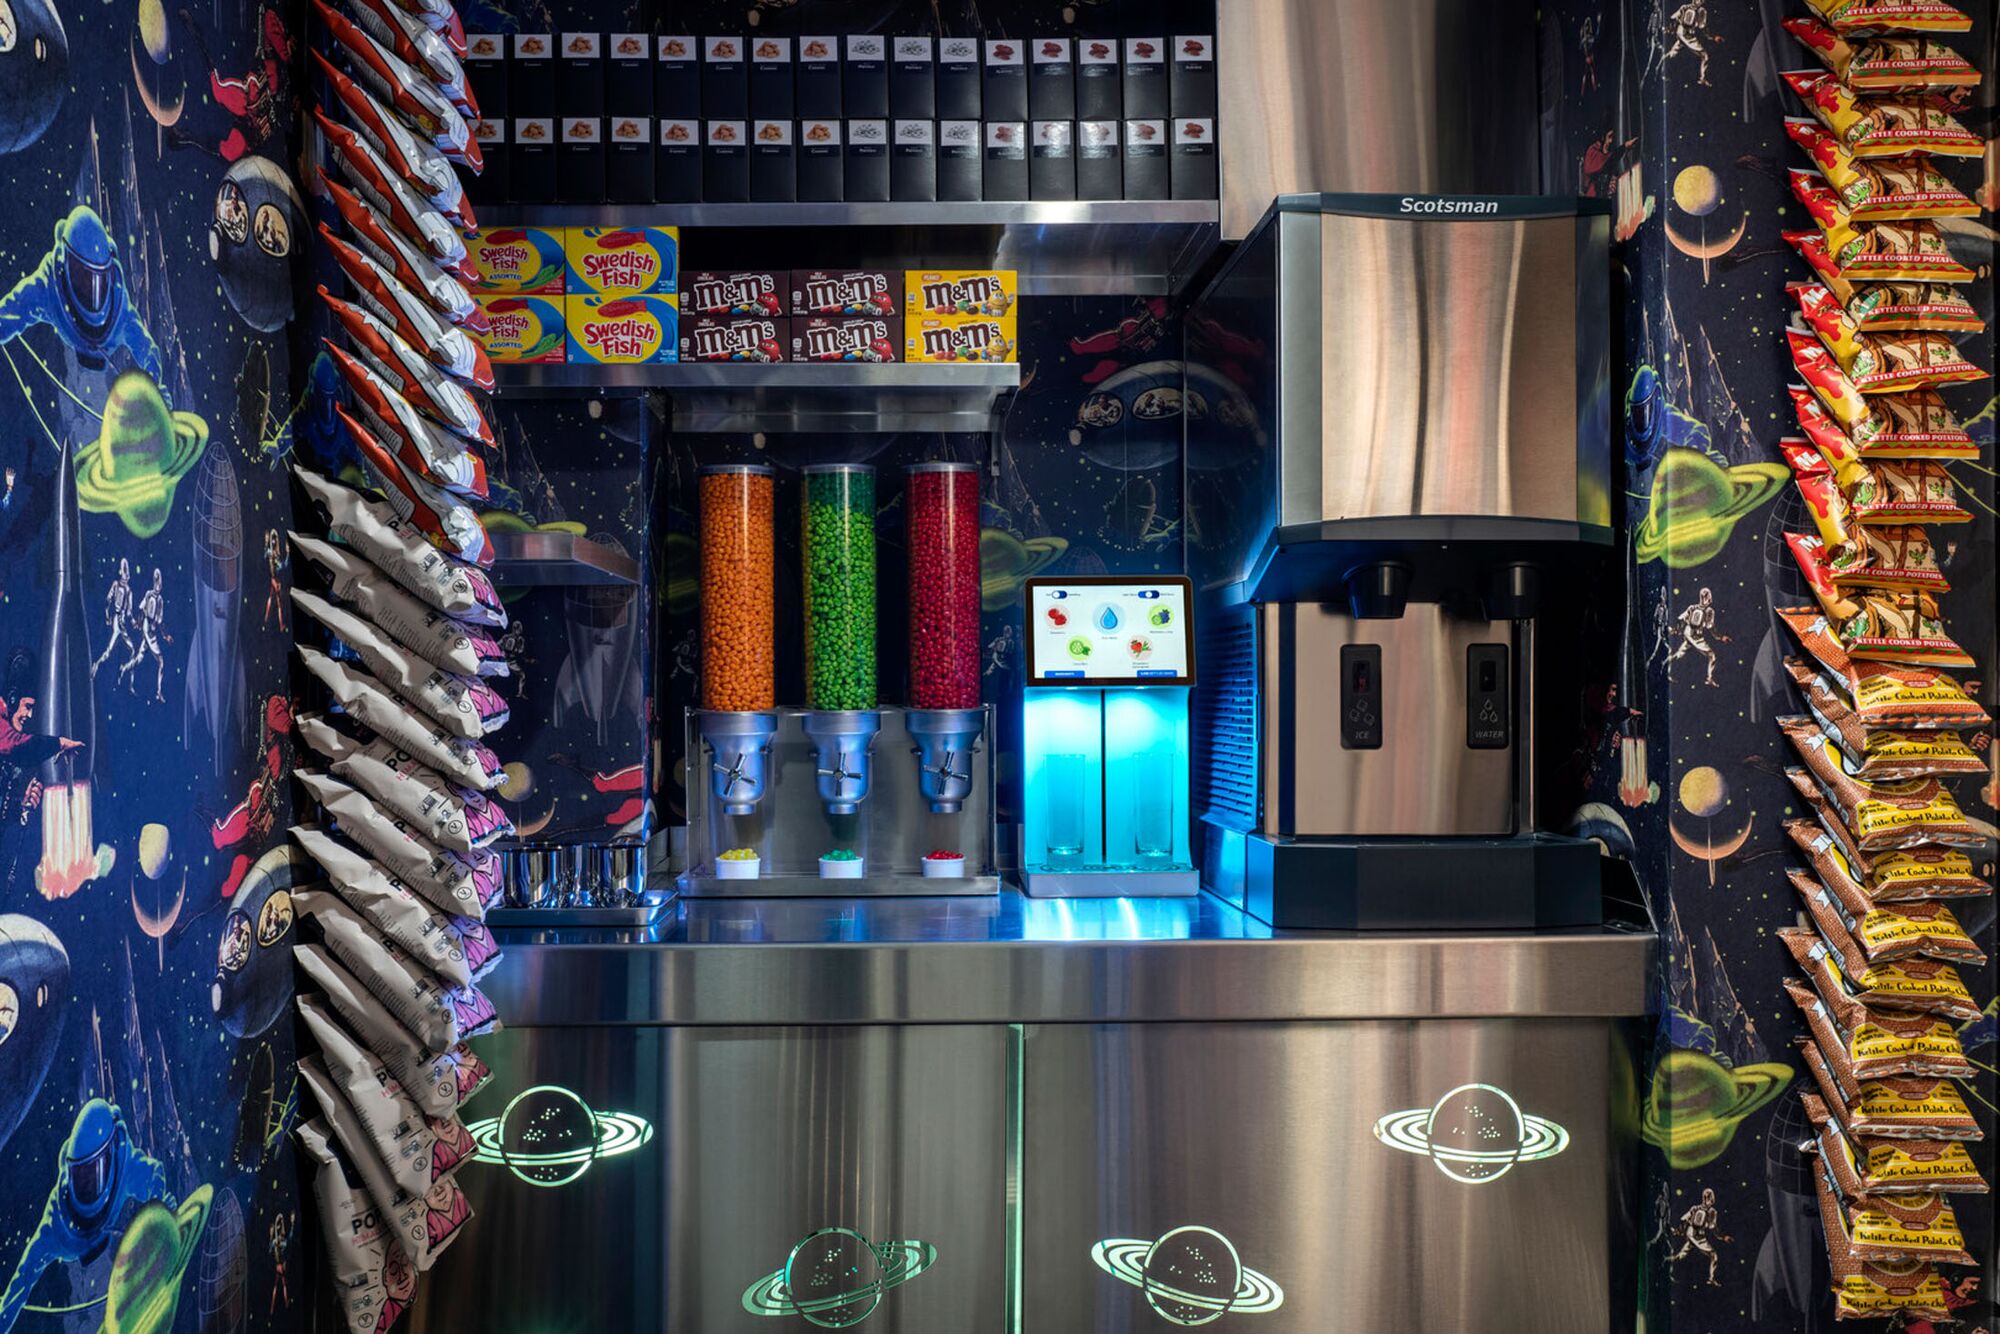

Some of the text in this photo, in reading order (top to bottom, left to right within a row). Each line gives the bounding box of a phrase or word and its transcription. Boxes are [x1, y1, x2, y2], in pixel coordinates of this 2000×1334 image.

[1865, 130, 1893, 138] ETTLE
[1400, 197, 1498, 213] Scotsman
[1864, 196, 1892, 204] ETTLE
[479, 246, 528, 263] Swedish
[1852, 255, 1883, 263] ETTLE
[491, 257, 520, 272] Fish
[582, 251, 656, 277] Swedish
[489, 273, 522, 281] ASSORTED
[598, 267, 643, 288] Fish
[488, 314, 529, 331] wedish
[492, 326, 520, 340] Fish
[583, 319, 657, 345] Swedish
[598, 336, 644, 357] Fish
[1896, 367, 1933, 377] COOKED
[1839, 567, 1869, 575] ETTLE
[1872, 568, 1905, 576] COOKED
[1888, 638, 1922, 646] COOKED
[1924, 639, 1961, 649] POTATO
[1895, 691, 1927, 700] Cooked
[1928, 692, 1953, 700] Potato
[1355, 731, 1368, 739] ICE
[1475, 731, 1504, 739] WATER
[1899, 747, 1931, 755] Cooked
[1891, 814, 1923, 824] Cooked
[1925, 813, 1951, 821] Potato
[1908, 867, 1938, 876] Cooked
[1940, 866, 1963, 875] Potato
[1901, 926, 1931, 935] Cooked
[1932, 926, 1954, 935] Potato
[1897, 983, 1927, 992] Cooked
[1930, 984, 1955, 993] Potato
[1886, 1043, 1914, 1053] Cookd
[1918, 1042, 1946, 1052] Potato
[1861, 1104, 1888, 1113] Kettle
[1890, 1103, 1921, 1113] Cooked
[1923, 1104, 1949, 1113] Potato
[1876, 1169, 1898, 1177] ettle
[1900, 1166, 1931, 1175] Cooked
[1933, 1165, 1959, 1174] Potato
[1859, 1231, 1888, 1241] Kettle
[1889, 1233, 1920, 1243] Cooked
[1923, 1236, 1947, 1246] Potato
